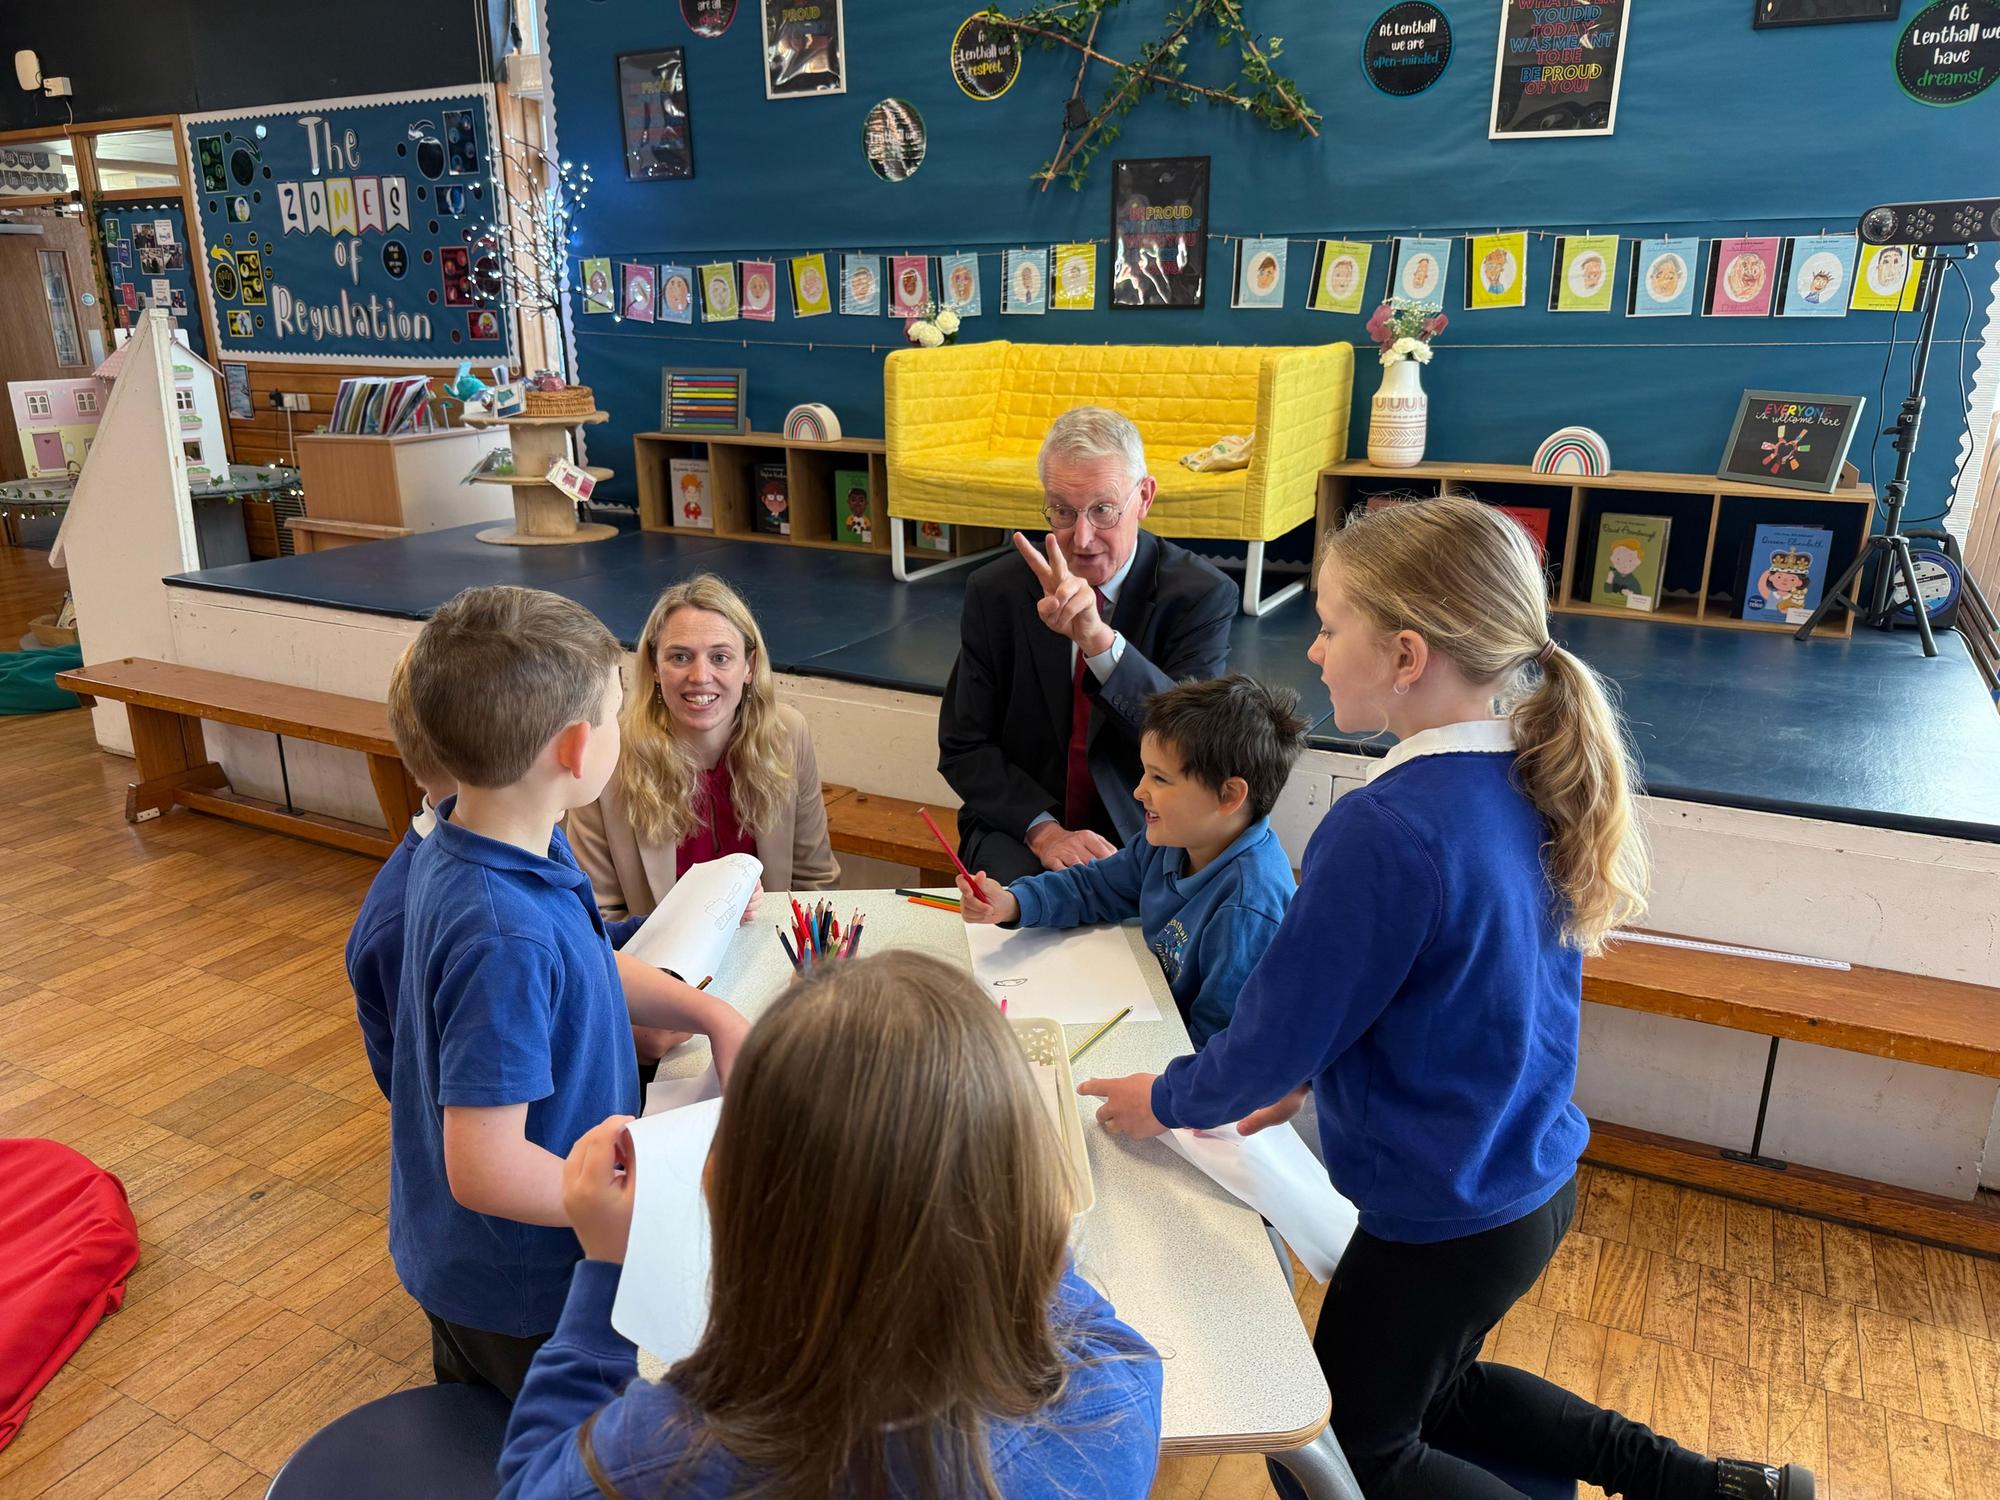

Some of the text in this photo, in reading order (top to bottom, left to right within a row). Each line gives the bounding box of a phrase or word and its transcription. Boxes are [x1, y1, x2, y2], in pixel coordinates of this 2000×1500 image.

[782, 6, 821, 22] PROUD
[1948, 3, 1970, 21] At
[1379, 18, 1437, 37] At Lenthall
[1530, 21, 1596, 38] TODAY
[1912, 23, 2000, 46] Lenthall we
[959, 43, 1012, 61] Lenthall we
[1391, 38, 1425, 52] we are
[1933, 47, 1971, 65] have
[1521, 63, 1603, 82] BE PROUD
[1916, 66, 1985, 87] dreams!
[1524, 81, 1547, 96] OF
[297, 116, 361, 176] The
[282, 185, 402, 222] ZONES
[1145, 205, 1193, 220] PROUD
[271, 283, 432, 342] Regulation
[1755, 411, 1841, 427] is welcome here
[1764, 403, 1832, 417] EVERYONE
